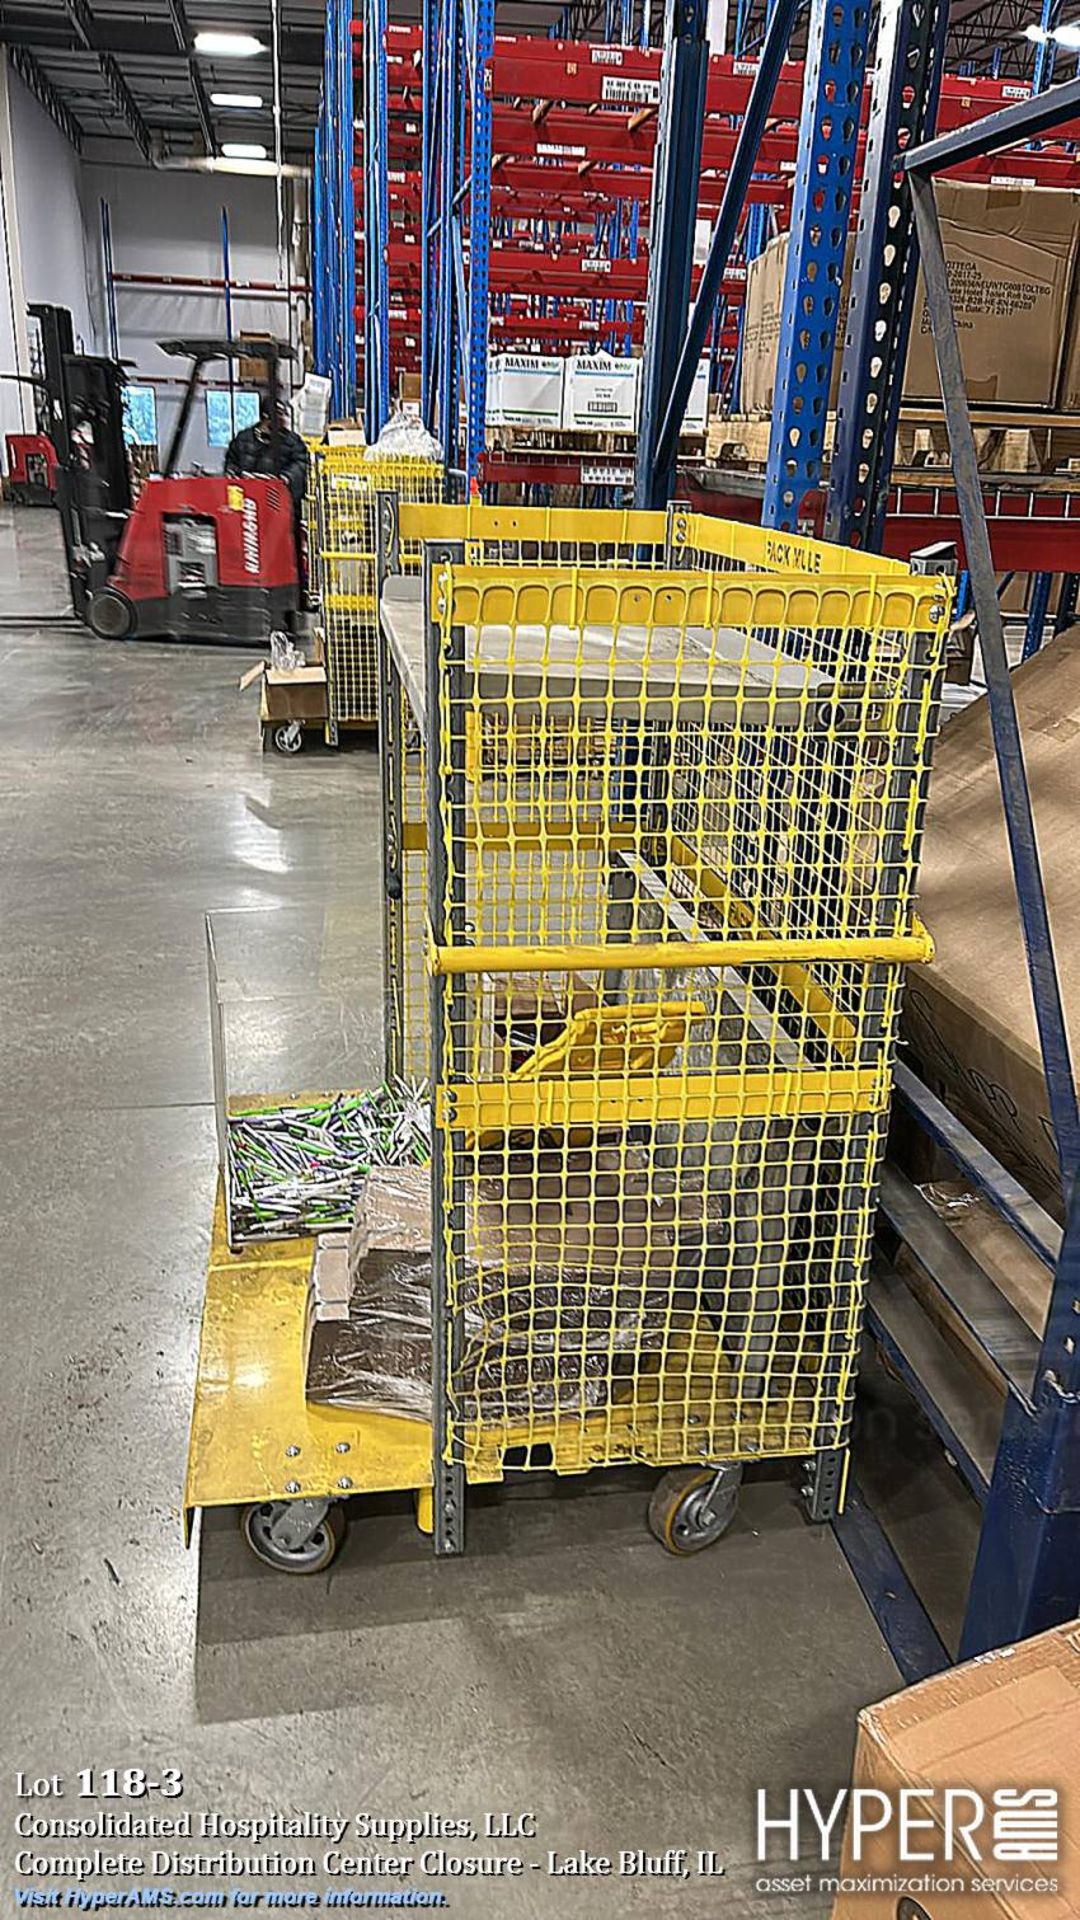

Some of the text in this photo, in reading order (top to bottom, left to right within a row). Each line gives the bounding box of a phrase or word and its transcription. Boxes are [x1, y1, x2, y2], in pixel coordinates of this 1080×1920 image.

[944, 261, 977, 271] OTTEGA
[504, 356, 540, 370] MAXIM
[576, 359, 612, 371] MAXIM
